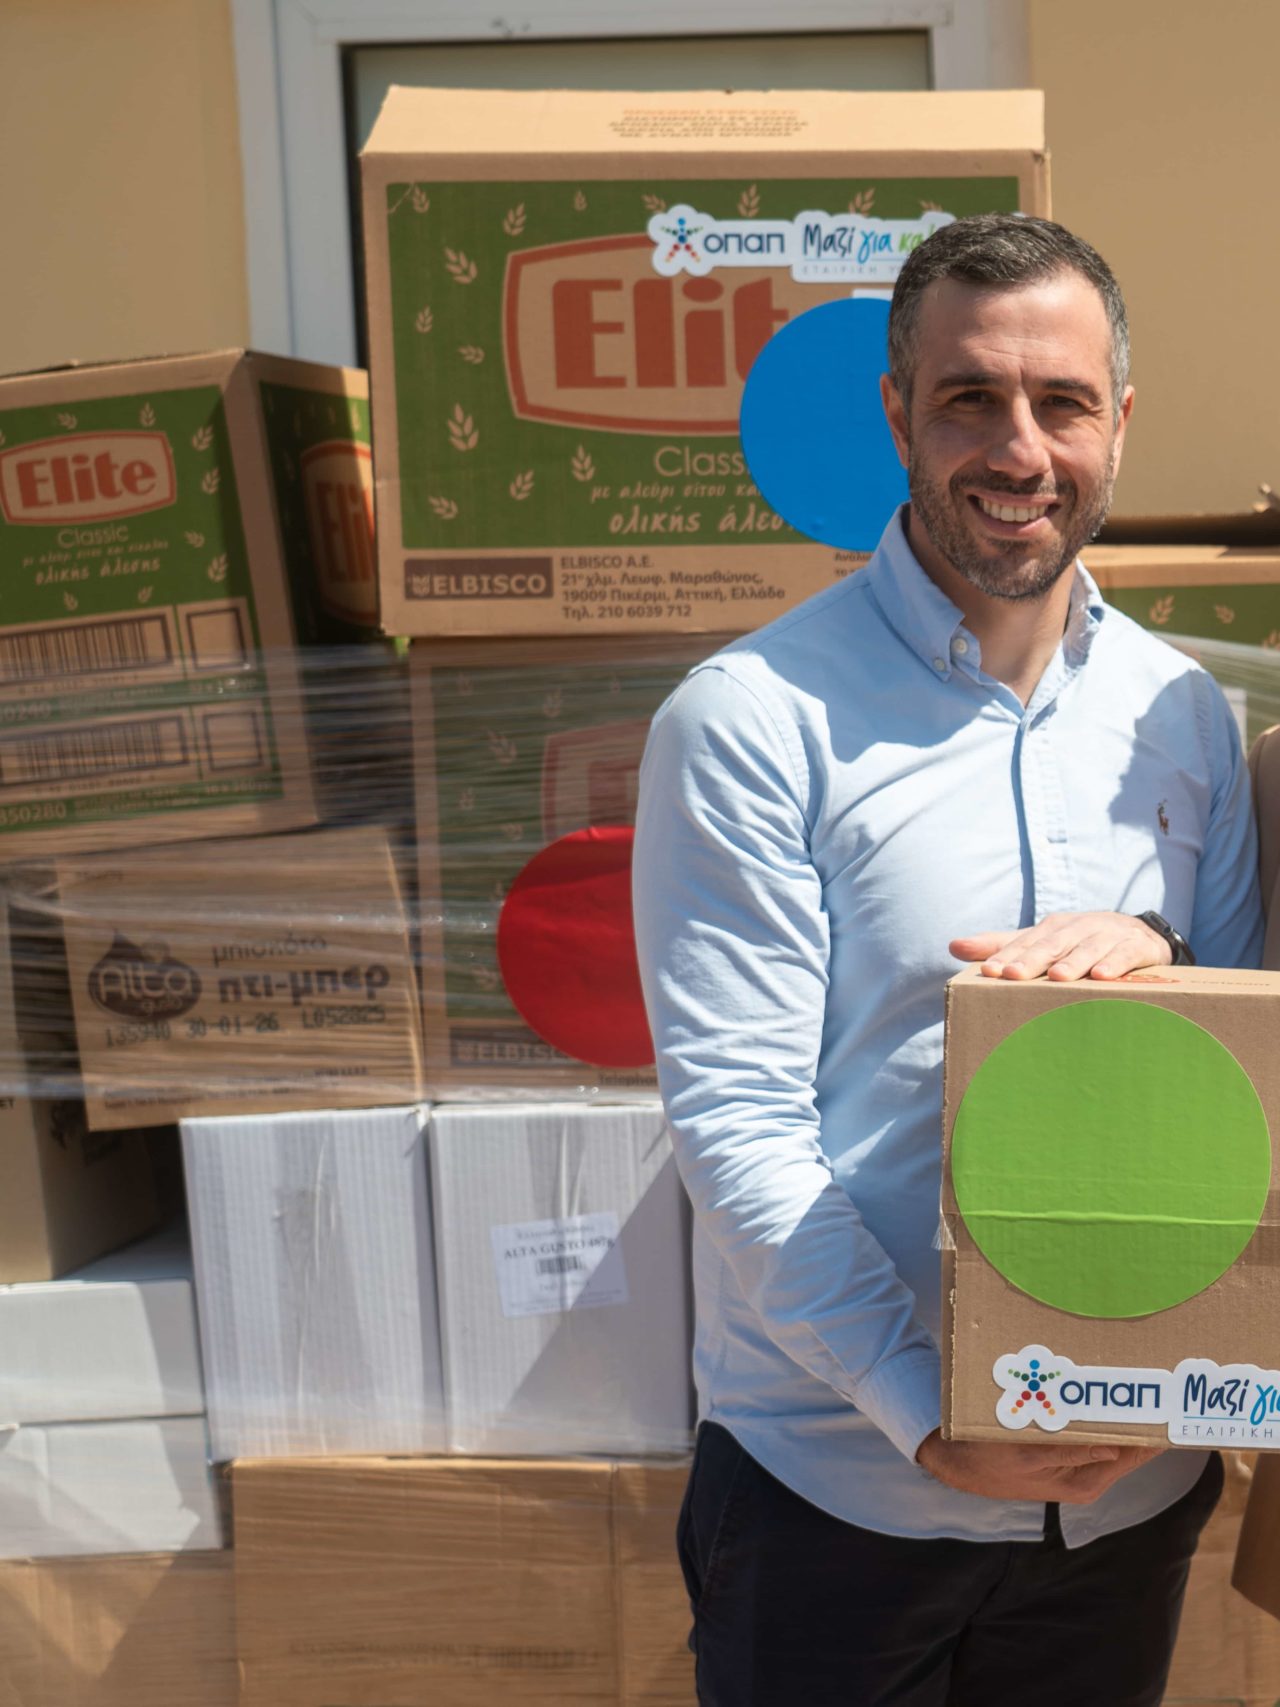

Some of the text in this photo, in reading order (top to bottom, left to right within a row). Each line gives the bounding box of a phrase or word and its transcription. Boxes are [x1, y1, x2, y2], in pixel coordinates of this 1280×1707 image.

[803, 223, 936, 264] Μαζί για κα
[552, 276, 790, 390] Elit
[654, 446, 750, 477] Class
[16, 449, 158, 510] Elite
[736, 484, 763, 498] κα
[57, 524, 130, 549] Classic
[561, 555, 623, 569] ELBISCO
[433, 574, 548, 596] ELBISCO
[562, 605, 595, 621] Τηλ.
[598, 605, 624, 618] 210
[667, 603, 693, 617] 712
[1182, 1373, 1250, 1417] Μαζί
[1182, 1424, 1274, 1440] ΕΤΑΙΡΙΚΗ
